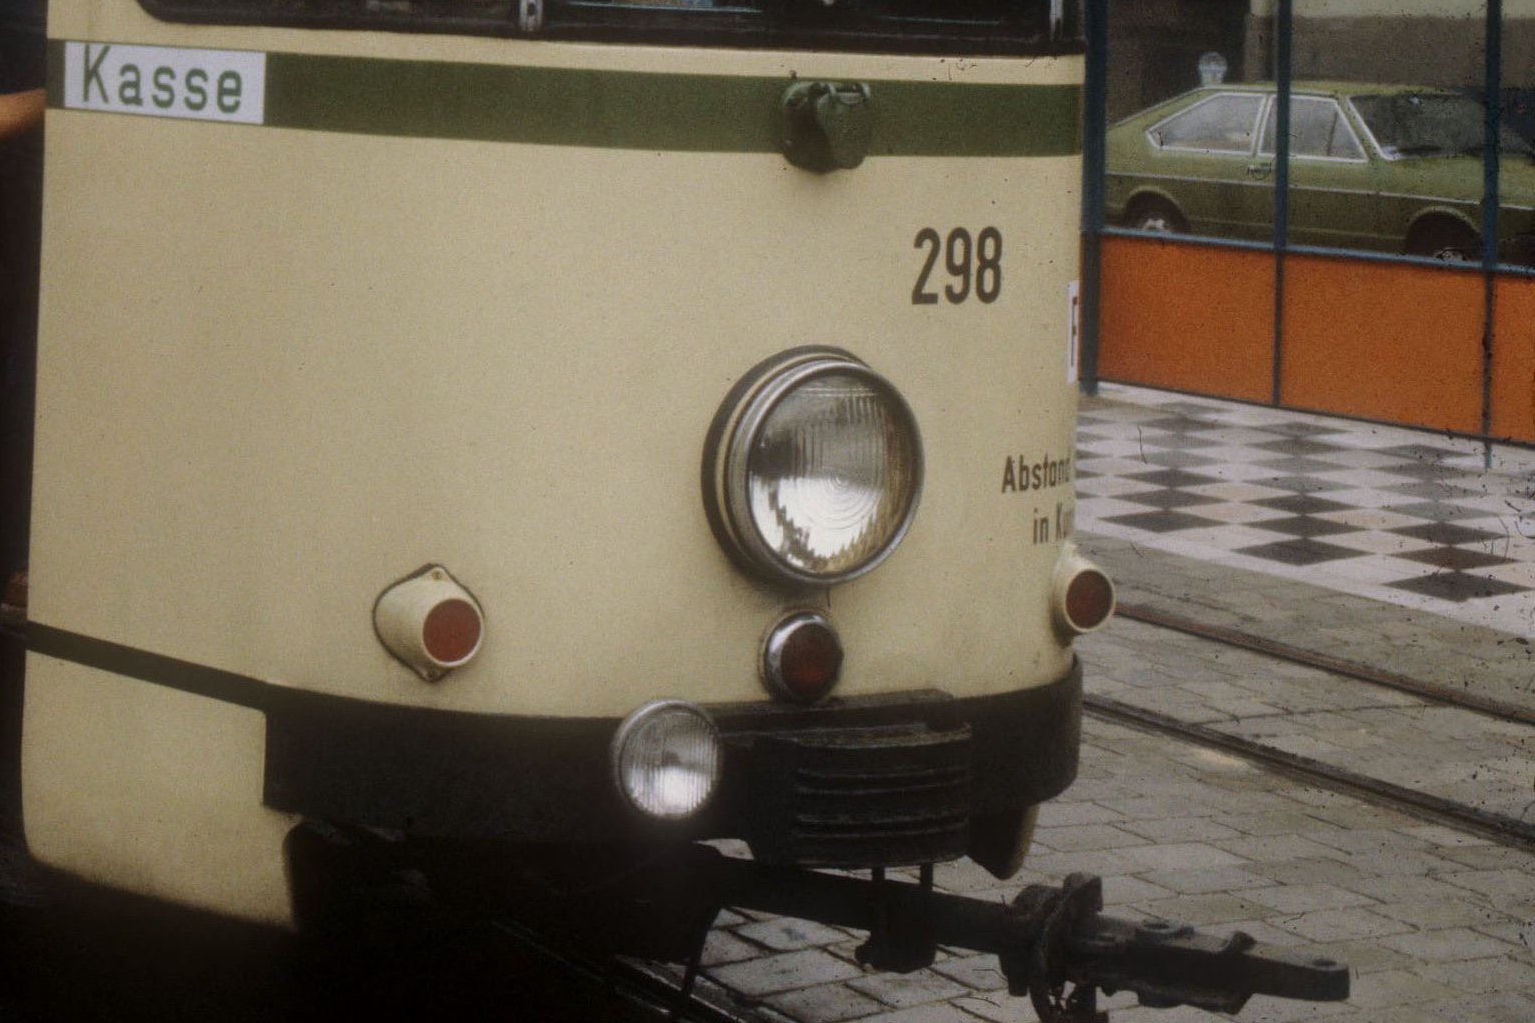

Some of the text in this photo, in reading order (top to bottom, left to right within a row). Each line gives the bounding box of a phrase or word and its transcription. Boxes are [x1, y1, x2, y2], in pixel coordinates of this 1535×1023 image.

[82, 43, 243, 114] Kasse
[911, 226, 1003, 305] 298
[1033, 508, 1050, 544] in
